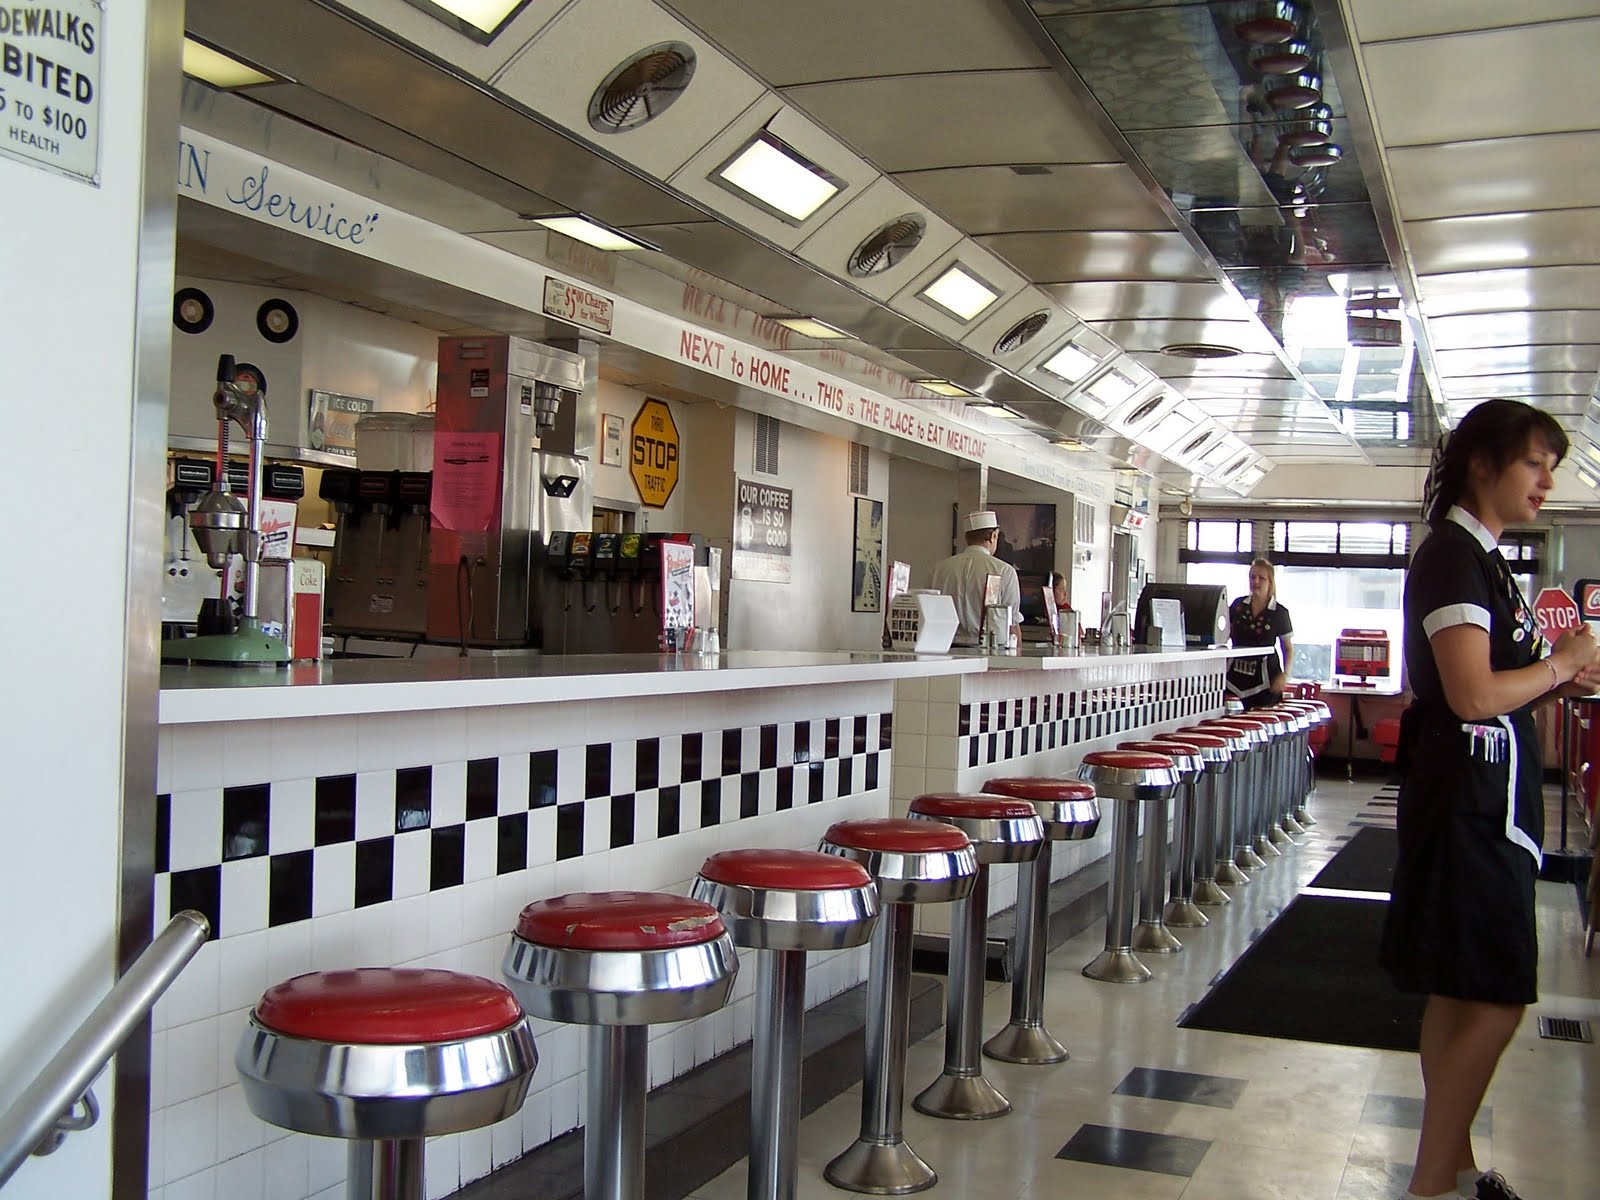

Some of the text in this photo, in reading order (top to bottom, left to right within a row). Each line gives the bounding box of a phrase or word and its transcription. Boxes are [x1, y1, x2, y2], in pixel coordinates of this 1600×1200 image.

[4, 42, 94, 105] BITED
[15, 100, 33, 120] TO
[43, 105, 87, 140] $100
[9, 125, 60, 155] HEALTH
[332, 398, 368, 413] ICE COLD
[680, 330, 725, 369] NEXT
[731, 350, 743, 377] to
[749, 356, 790, 393] HOME
[817, 381, 843, 412] THIS
[847, 396, 855, 416] is
[860, 397, 880, 424] THE
[884, 406, 914, 436] PLACE
[917, 421, 924, 440] to
[927, 423, 944, 446] EAT
[947, 429, 987, 460] MEATLOAF
[634, 435, 677, 471] STOP
[740, 485, 789, 510] OUR COFFEE
[773, 511, 785, 528] SO
[766, 529, 788, 548] GOOD
[300, 573, 318, 586] Coke
[1537, 606, 1576, 629] STOP
